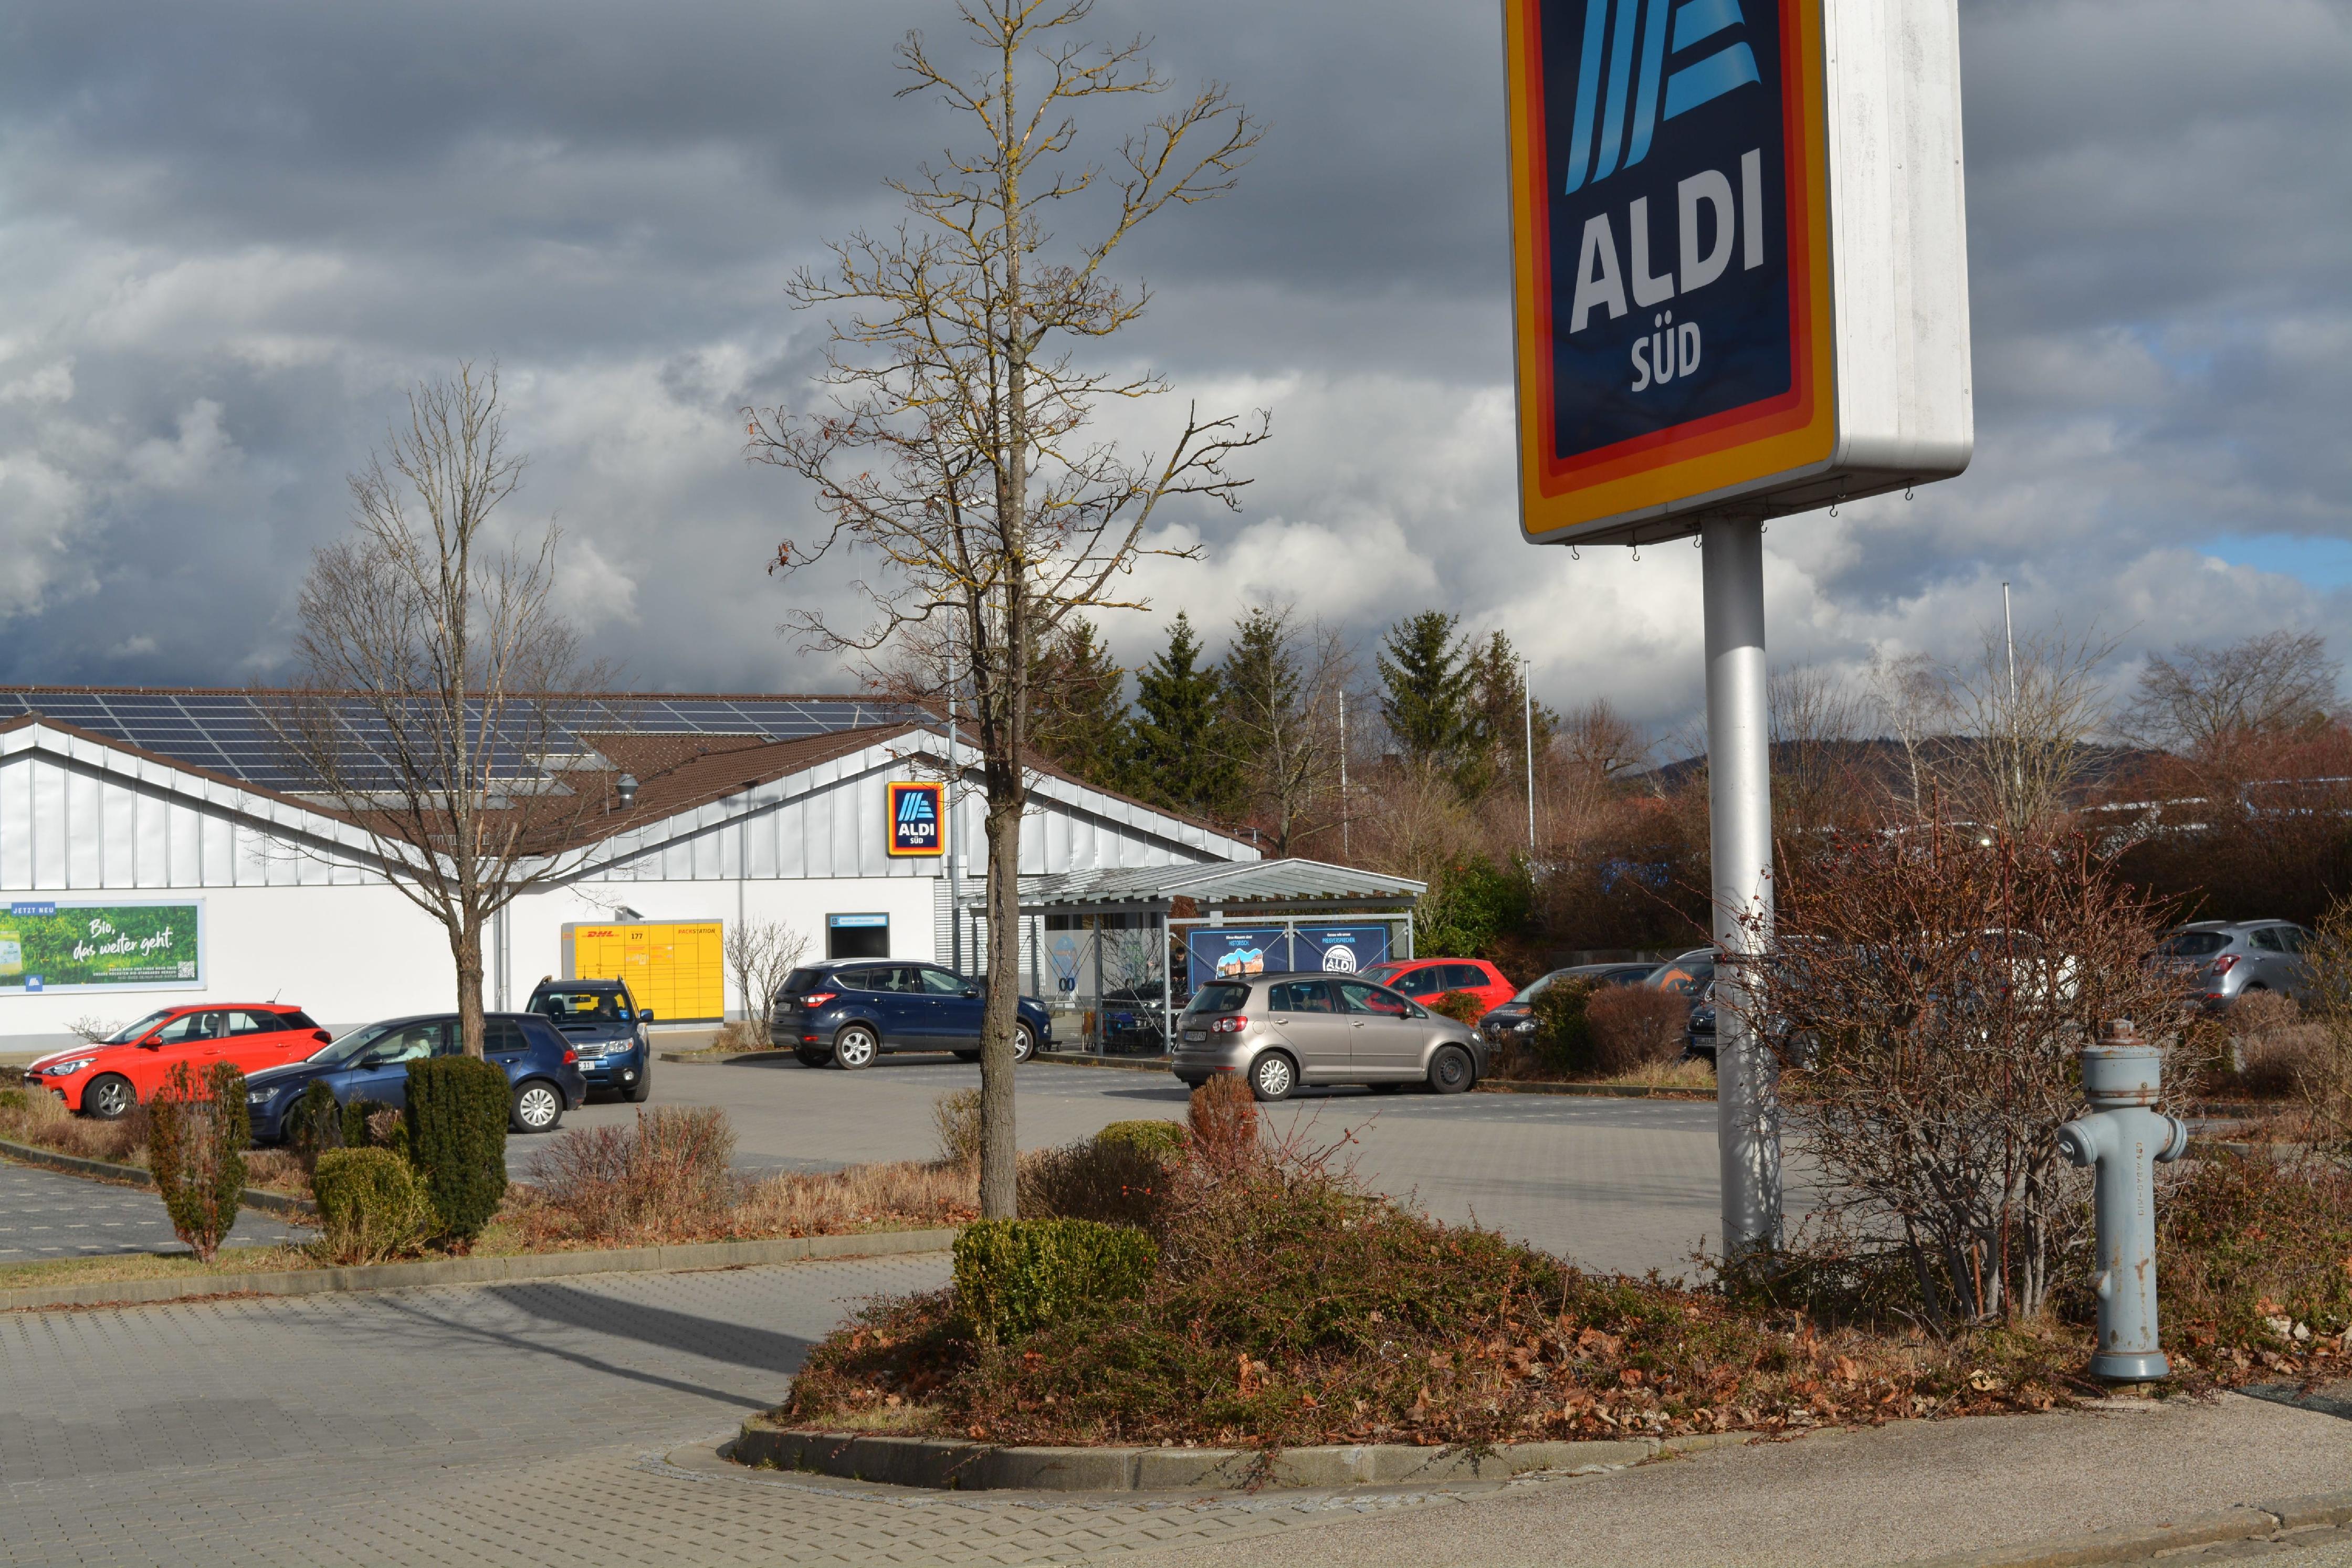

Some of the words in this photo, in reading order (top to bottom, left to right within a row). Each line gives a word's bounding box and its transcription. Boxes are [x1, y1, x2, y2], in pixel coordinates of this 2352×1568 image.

[1569, 148, 1763, 334] ALDI
[1631, 310, 1701, 392] SÜD
[898, 823, 934, 836] ALDI
[89, 919, 116, 938] Bio,
[73, 940, 96, 962] das
[99, 932, 138, 954] weiter
[140, 926, 173, 956] geht.
[1326, 958, 1353, 972] ALDI
